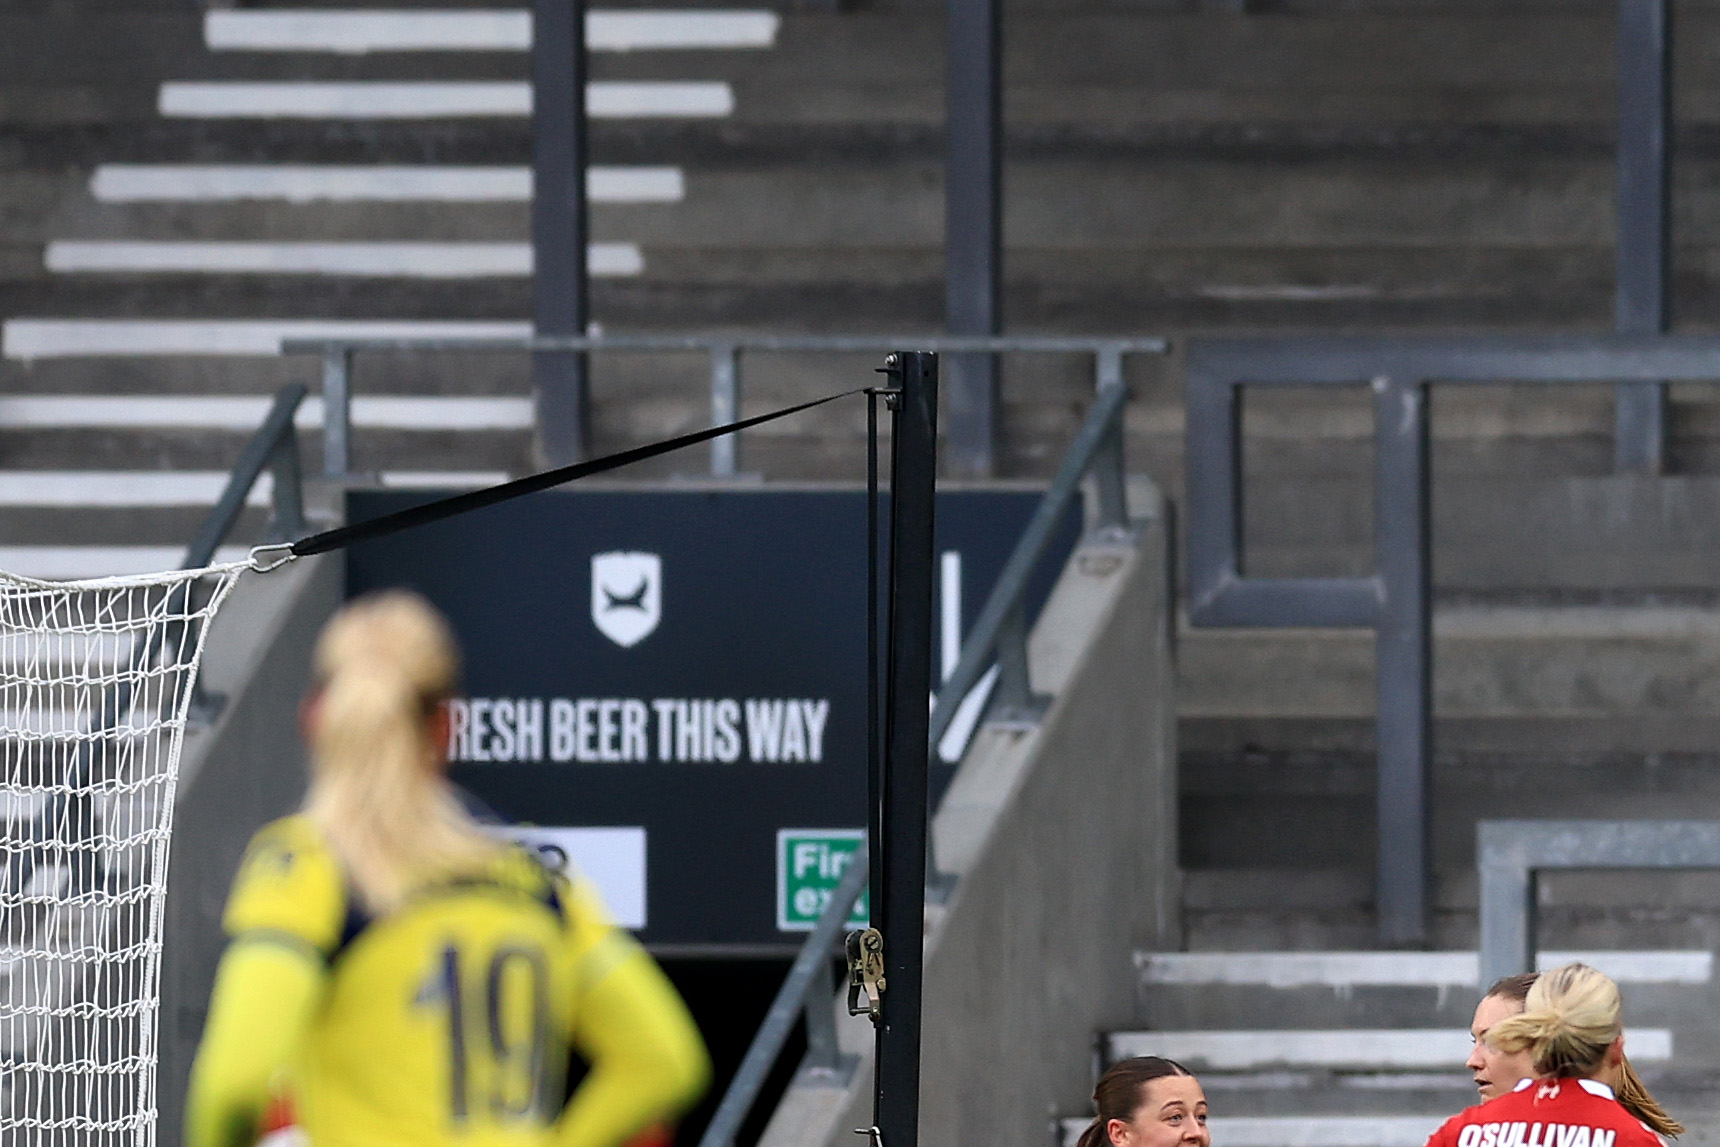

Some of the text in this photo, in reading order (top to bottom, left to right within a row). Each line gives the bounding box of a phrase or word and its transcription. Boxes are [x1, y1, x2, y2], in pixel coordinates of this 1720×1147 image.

[448, 698, 829, 762] RESH BEER THIS WAY
[794, 842, 858, 879] Fir
